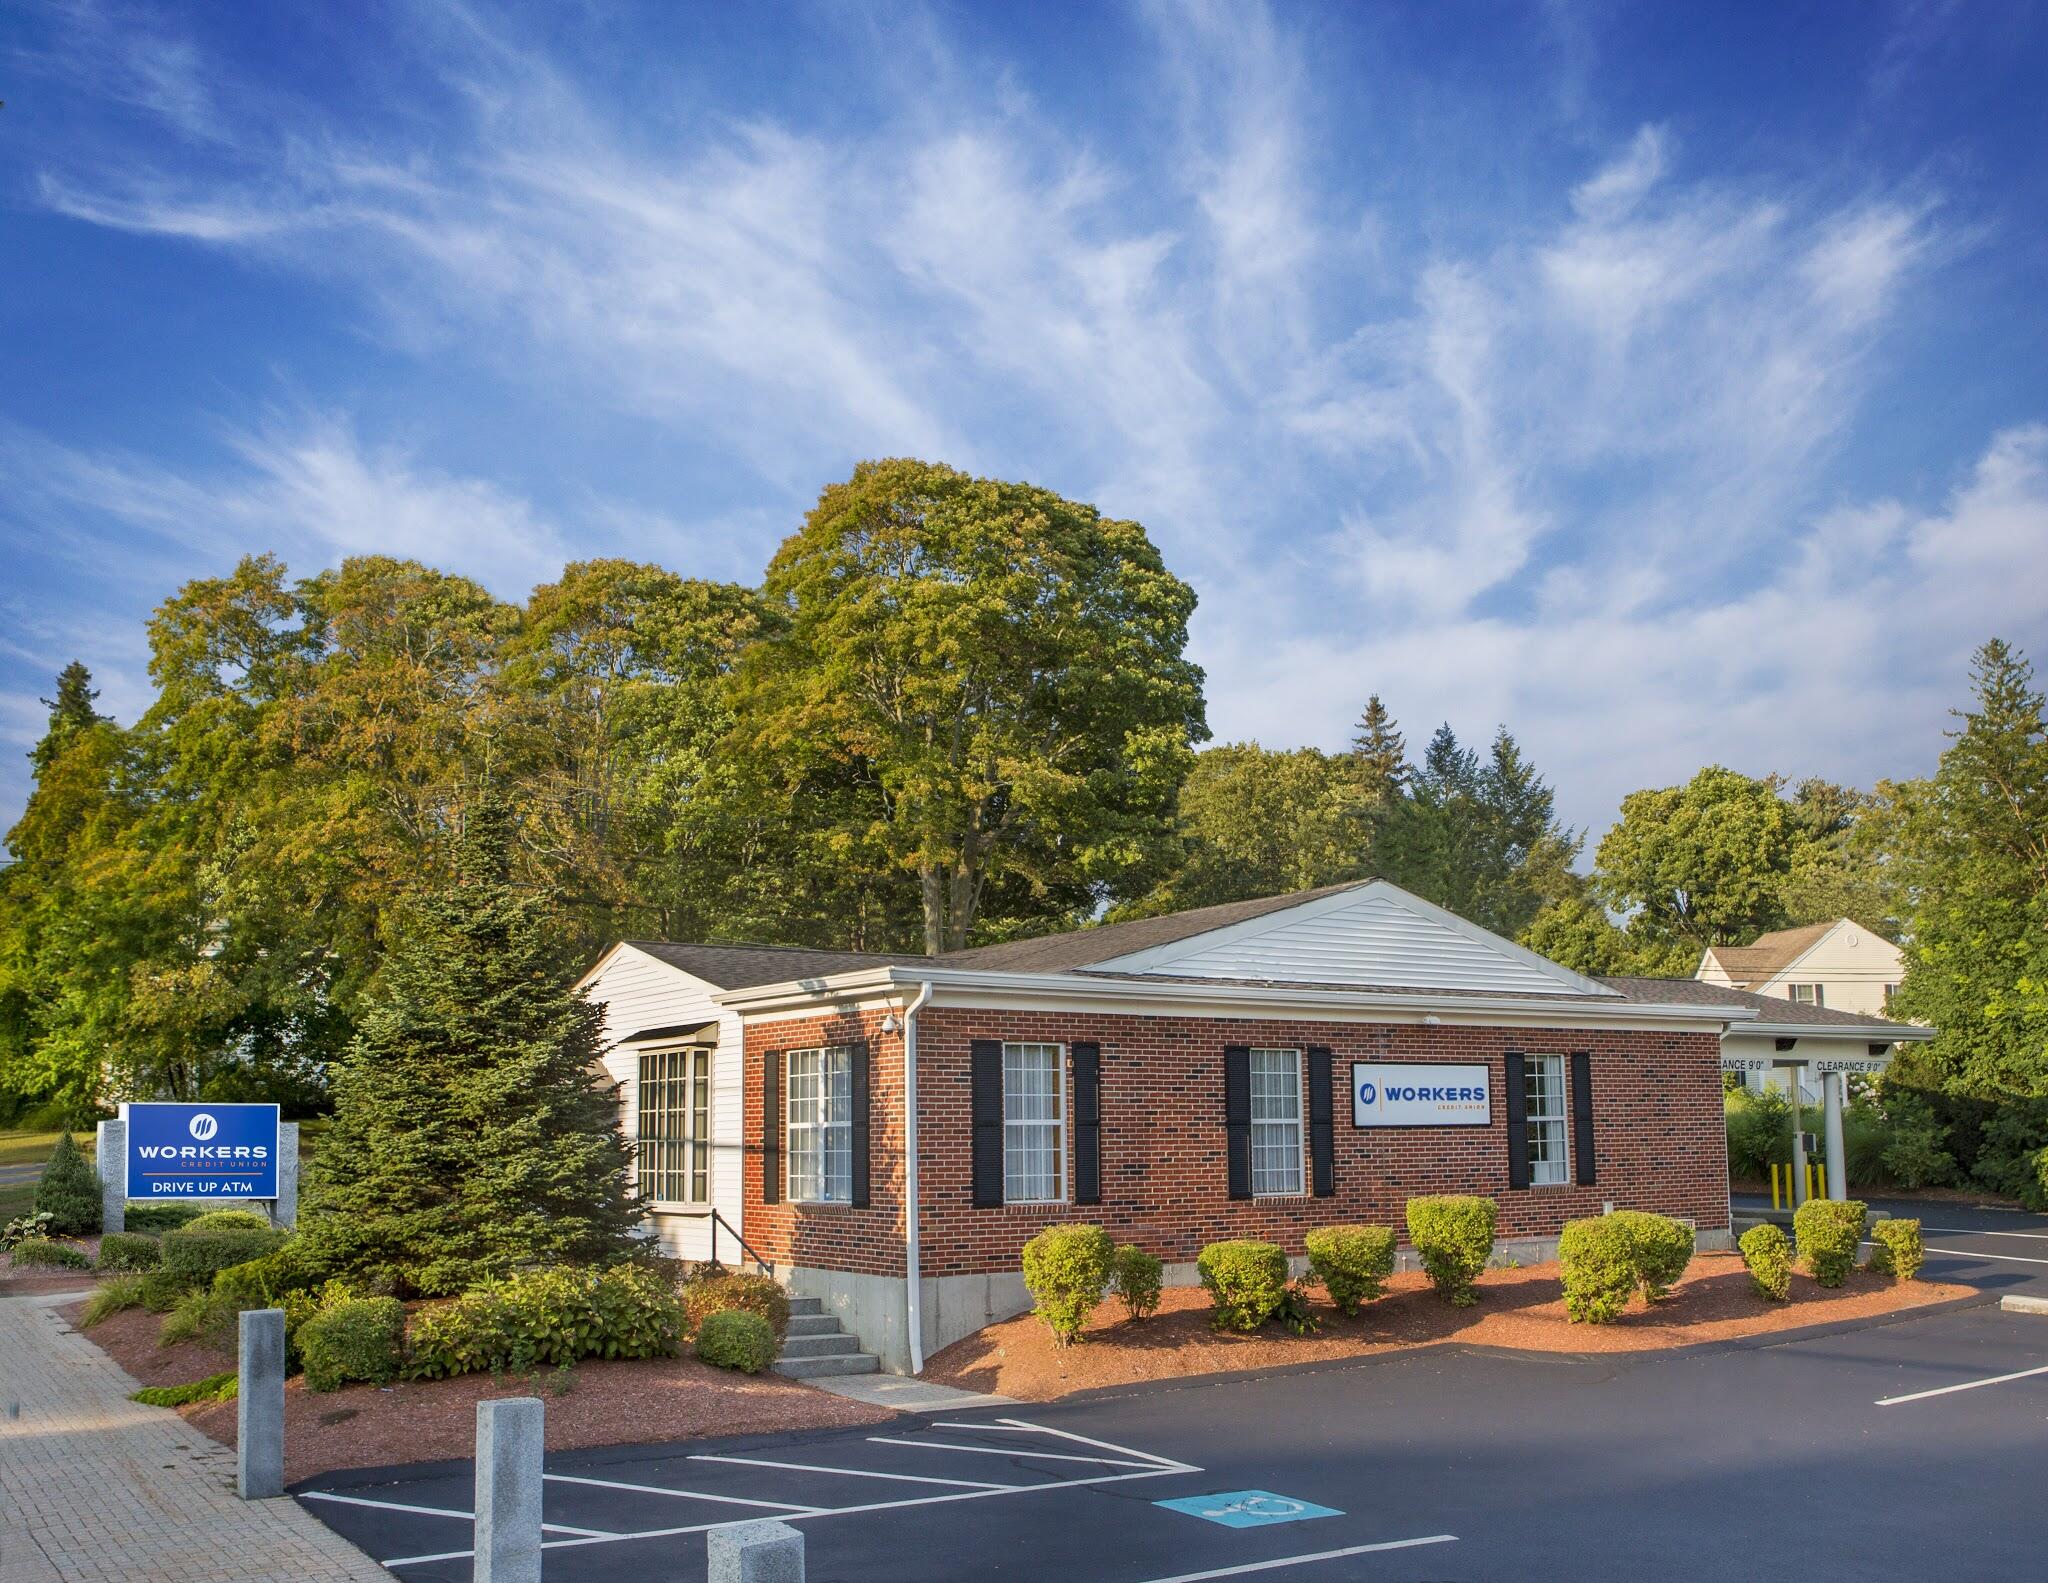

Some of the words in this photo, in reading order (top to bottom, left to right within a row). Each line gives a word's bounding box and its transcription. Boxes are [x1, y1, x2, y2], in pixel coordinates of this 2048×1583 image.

[1816, 1061, 1865, 1072] CLEARANCE
[1384, 1087, 1485, 1101] WORKERS
[139, 1146, 268, 1159] WORKERS
[152, 1182, 194, 1193] DRIVE
[198, 1182, 218, 1193] UP
[221, 1182, 253, 1192] ATM
